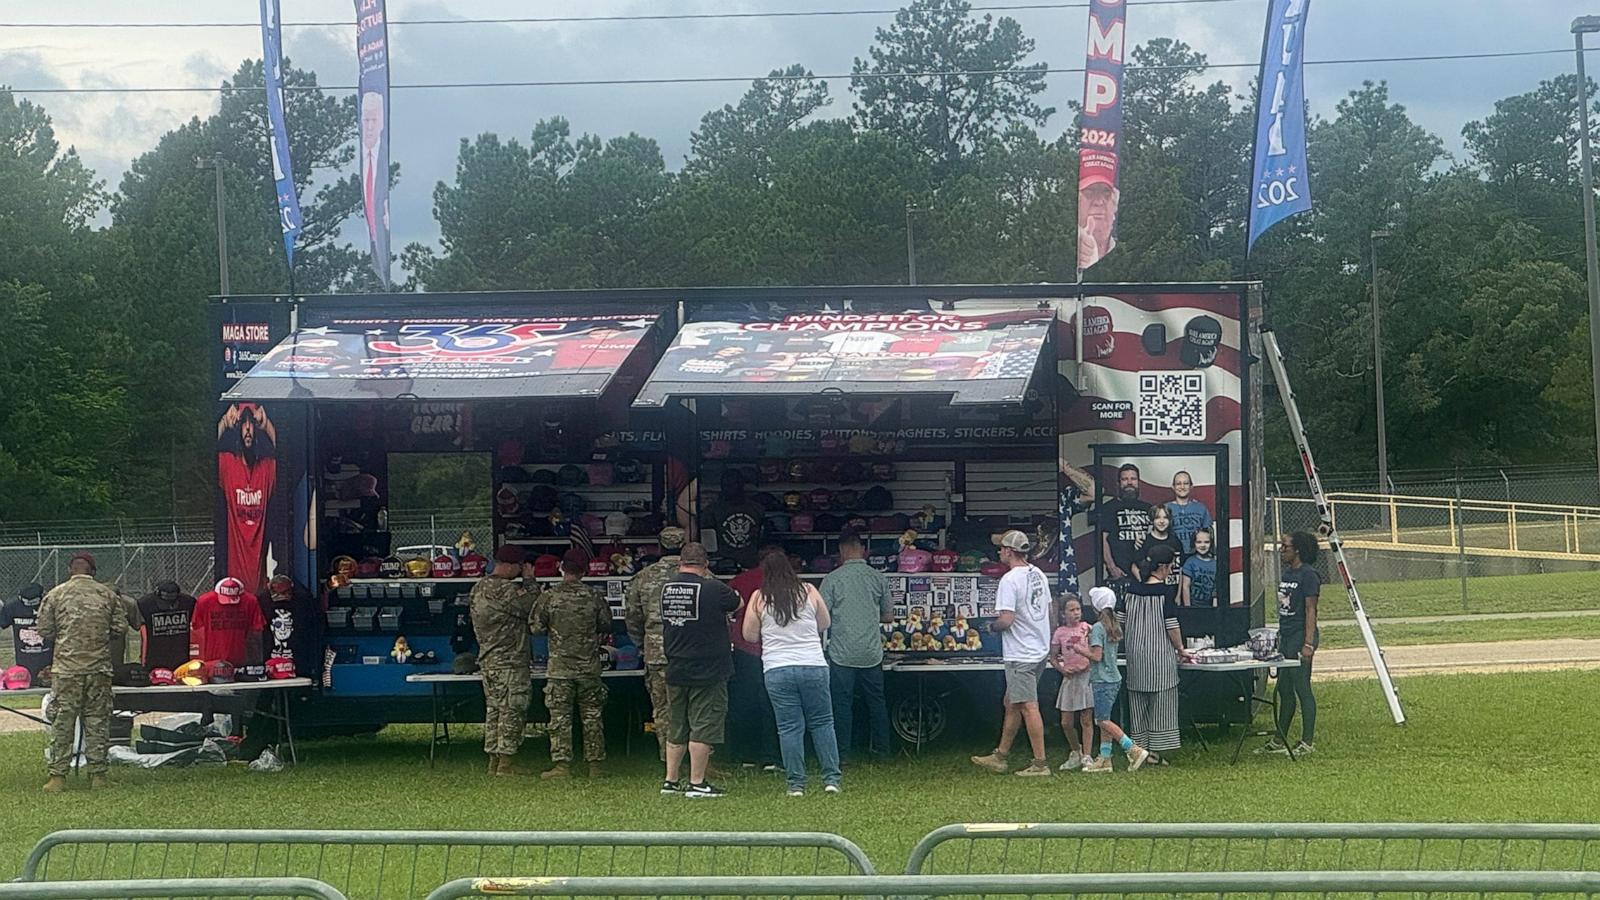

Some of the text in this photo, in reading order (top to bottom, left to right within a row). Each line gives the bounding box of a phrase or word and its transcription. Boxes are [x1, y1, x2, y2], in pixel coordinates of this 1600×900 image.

[1081, 128, 1115, 147] 2024
[788, 314, 956, 322] MINDSET OF
[744, 321, 984, 331] CHAMPIONS
[223, 326, 269, 340] MAGA STORE
[368, 323, 567, 357] 365
[954, 426, 1019, 438] STICKERS,
[236, 488, 262, 506] TRUMP
[1118, 515, 1151, 526] LIONS
[220, 586, 240, 596] TRUMP
[154, 614, 187, 627] MAGA
